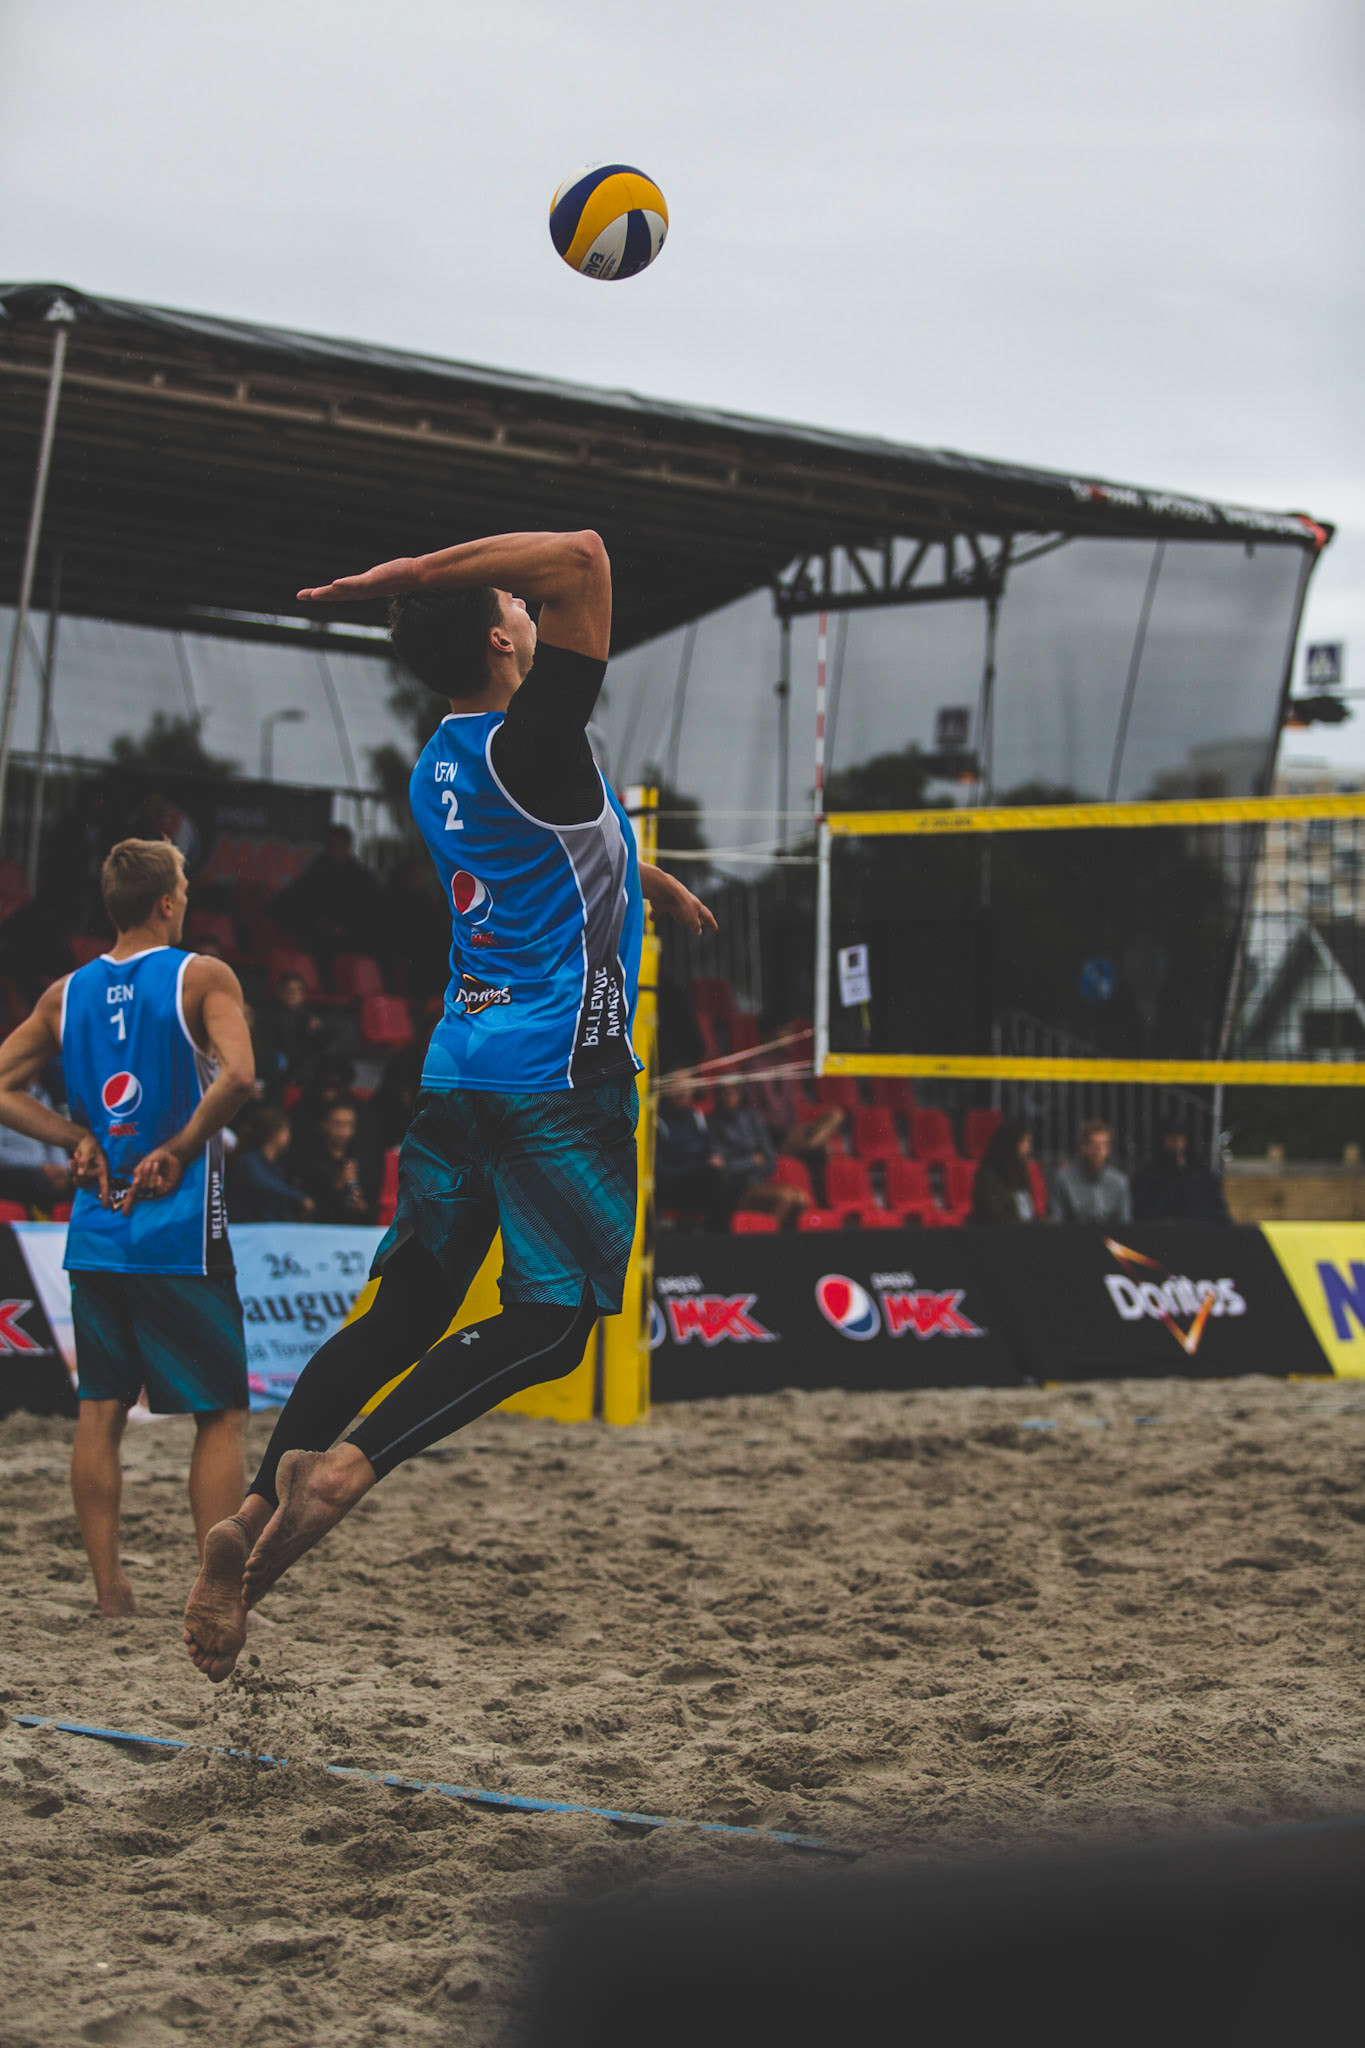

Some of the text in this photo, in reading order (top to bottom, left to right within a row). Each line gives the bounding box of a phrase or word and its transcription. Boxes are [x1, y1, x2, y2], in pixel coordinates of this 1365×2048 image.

[441, 790, 464, 831] 2
[106, 984, 134, 1004] DEN
[110, 1008, 126, 1040] 1
[211, 1171, 223, 1240] BELLEVUE
[1103, 1273, 1246, 1320] Doritos
